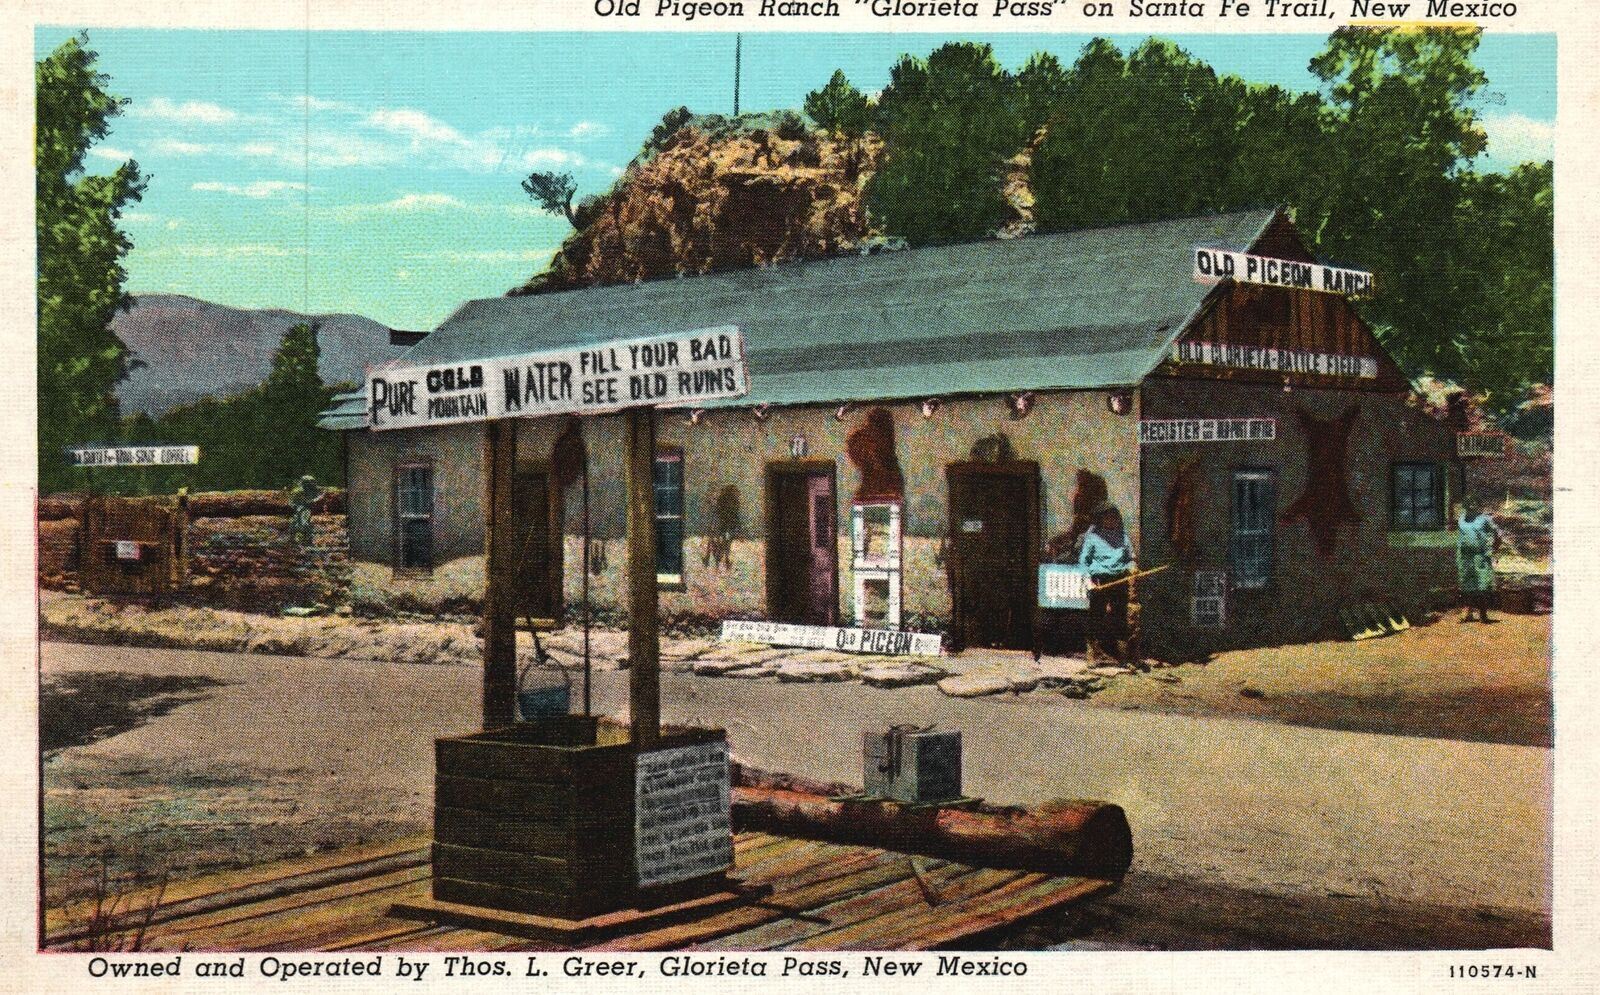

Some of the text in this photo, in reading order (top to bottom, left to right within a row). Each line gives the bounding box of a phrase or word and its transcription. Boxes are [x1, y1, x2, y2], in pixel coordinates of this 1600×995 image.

[1197, 250, 1235, 277] OLD
[1322, 266, 1373, 297] RANCH
[579, 348, 622, 376] FILL
[628, 340, 680, 371] YOUR
[426, 364, 484, 394] COLD
[502, 360, 573, 412] WATER
[581, 366, 737, 405] SEE OLD RUINS
[370, 376, 419, 426] PURE
[427, 392, 489, 420] MOUNTAIN
[1140, 420, 1201, 441] REGISTER
